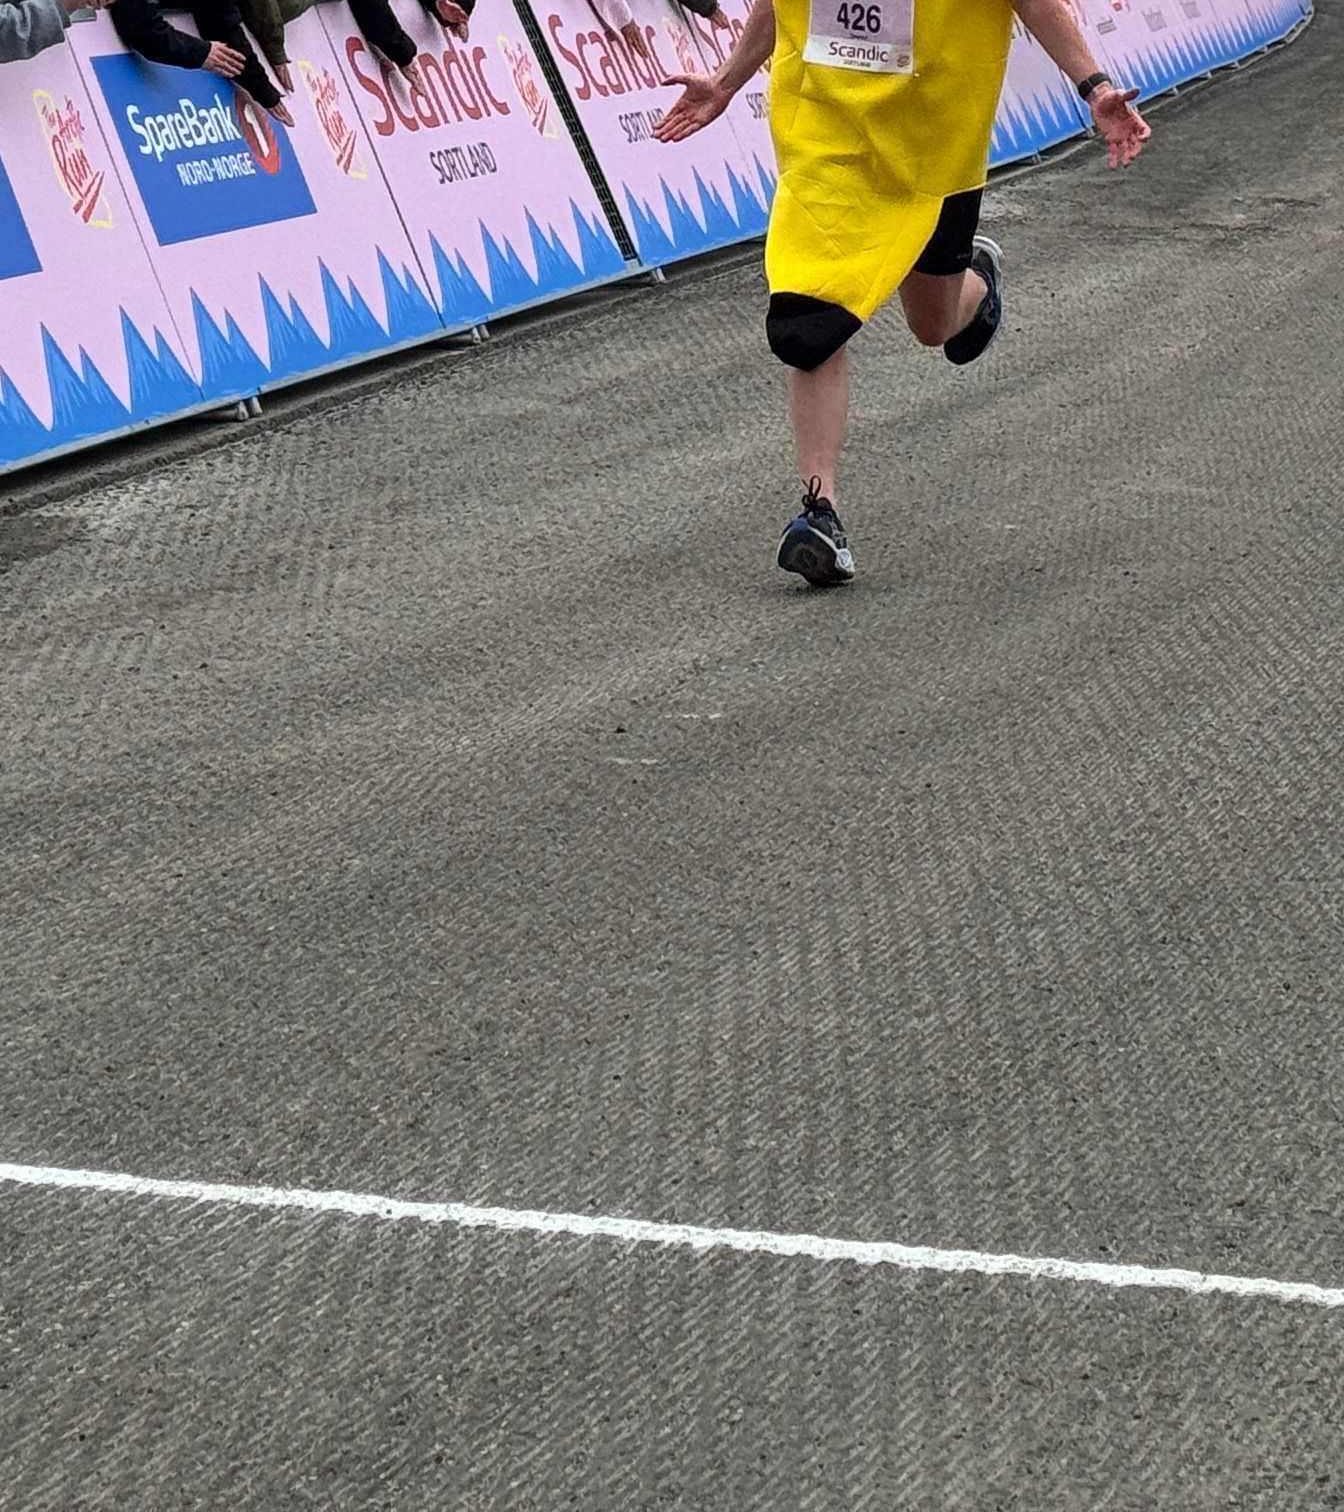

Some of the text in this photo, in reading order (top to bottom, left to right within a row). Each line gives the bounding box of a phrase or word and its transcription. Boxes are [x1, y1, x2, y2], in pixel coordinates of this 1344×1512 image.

[837, 2, 881, 34] 426
[828, 41, 889, 63] Scandic
[346, 26, 511, 136] Scandic
[127, 92, 243, 162] SpareBank
[176, 151, 256, 187] NORD-NORGE
[430, 142, 497, 185] SORTLAND
